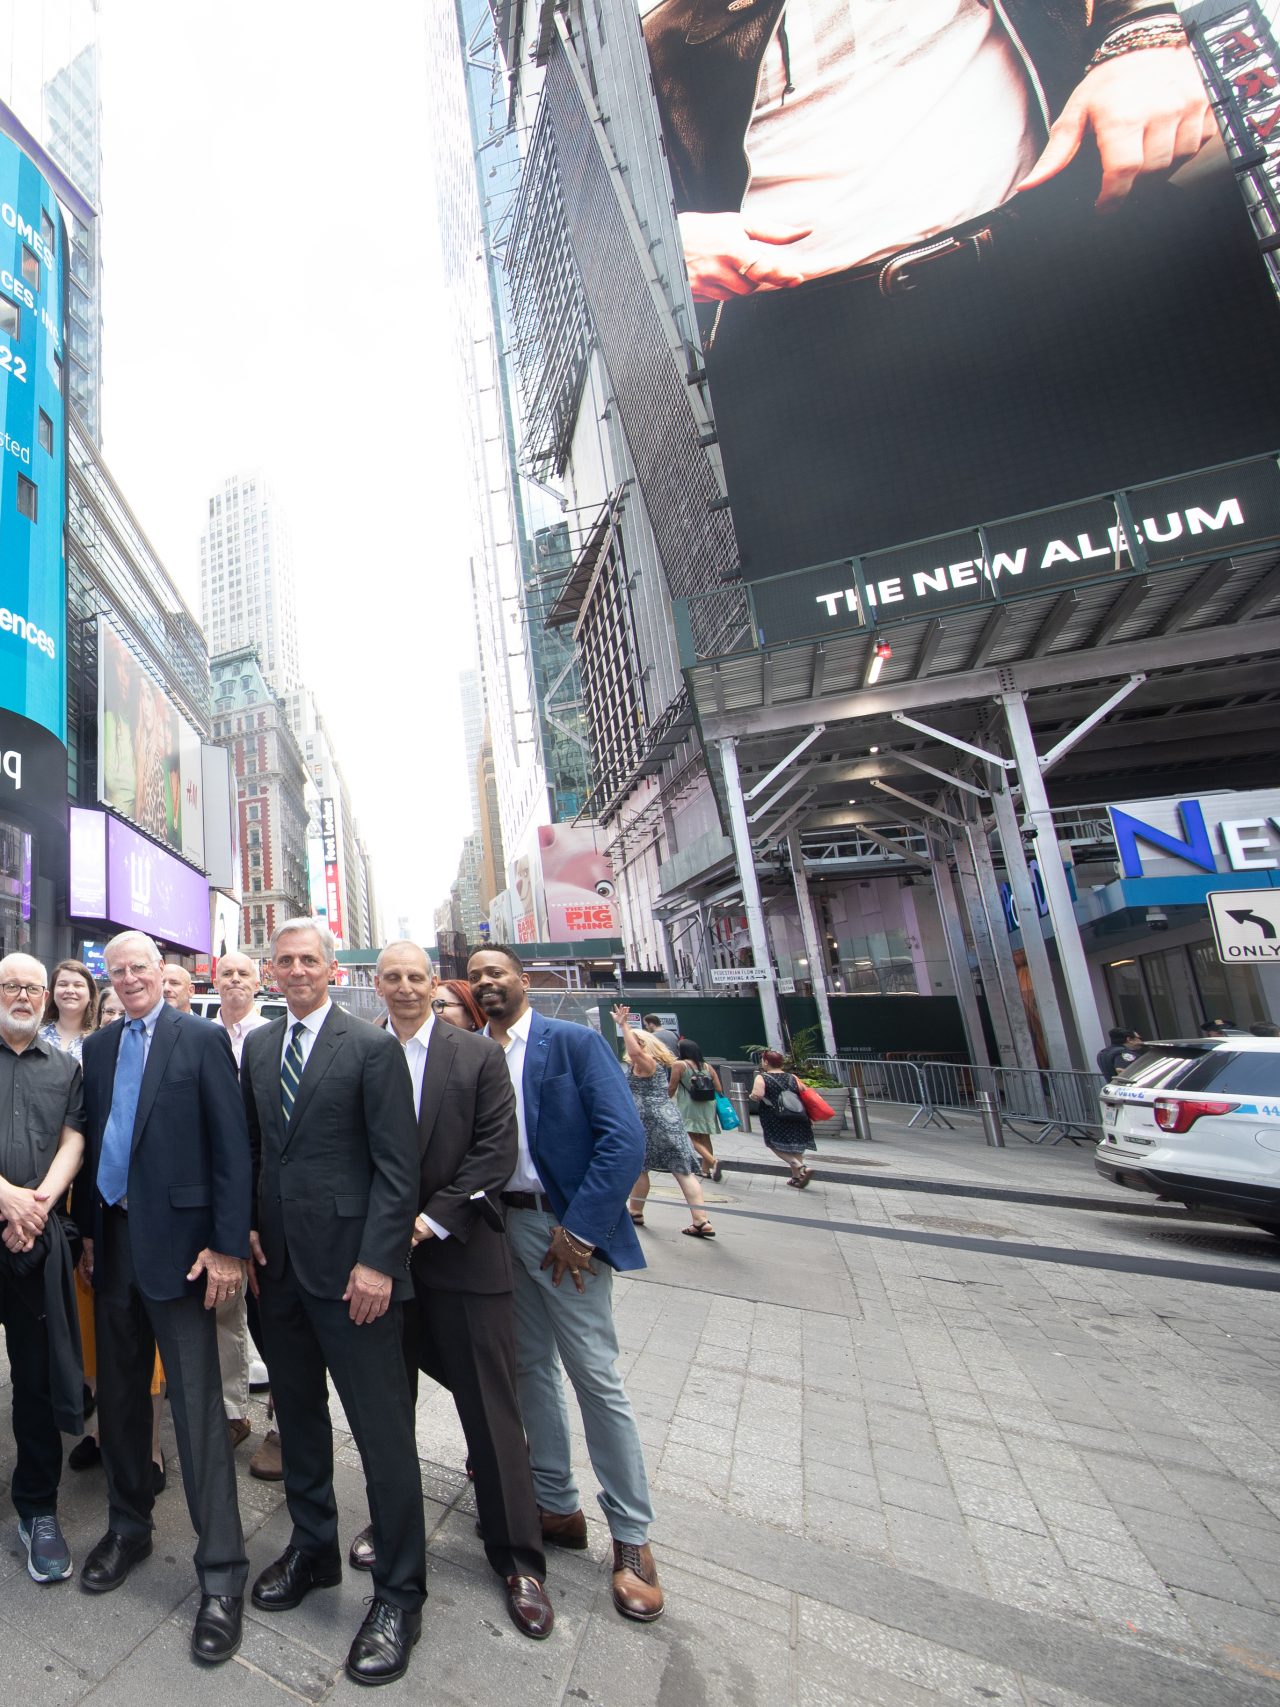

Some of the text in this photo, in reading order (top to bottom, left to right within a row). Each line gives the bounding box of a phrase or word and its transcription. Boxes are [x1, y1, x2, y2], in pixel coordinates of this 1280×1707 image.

[815, 577, 905, 616] THE
[912, 548, 1028, 597] NEW
[1107, 799, 1280, 878] NE
[565, 910, 612, 924] PIG
[567, 921, 614, 931] THING
